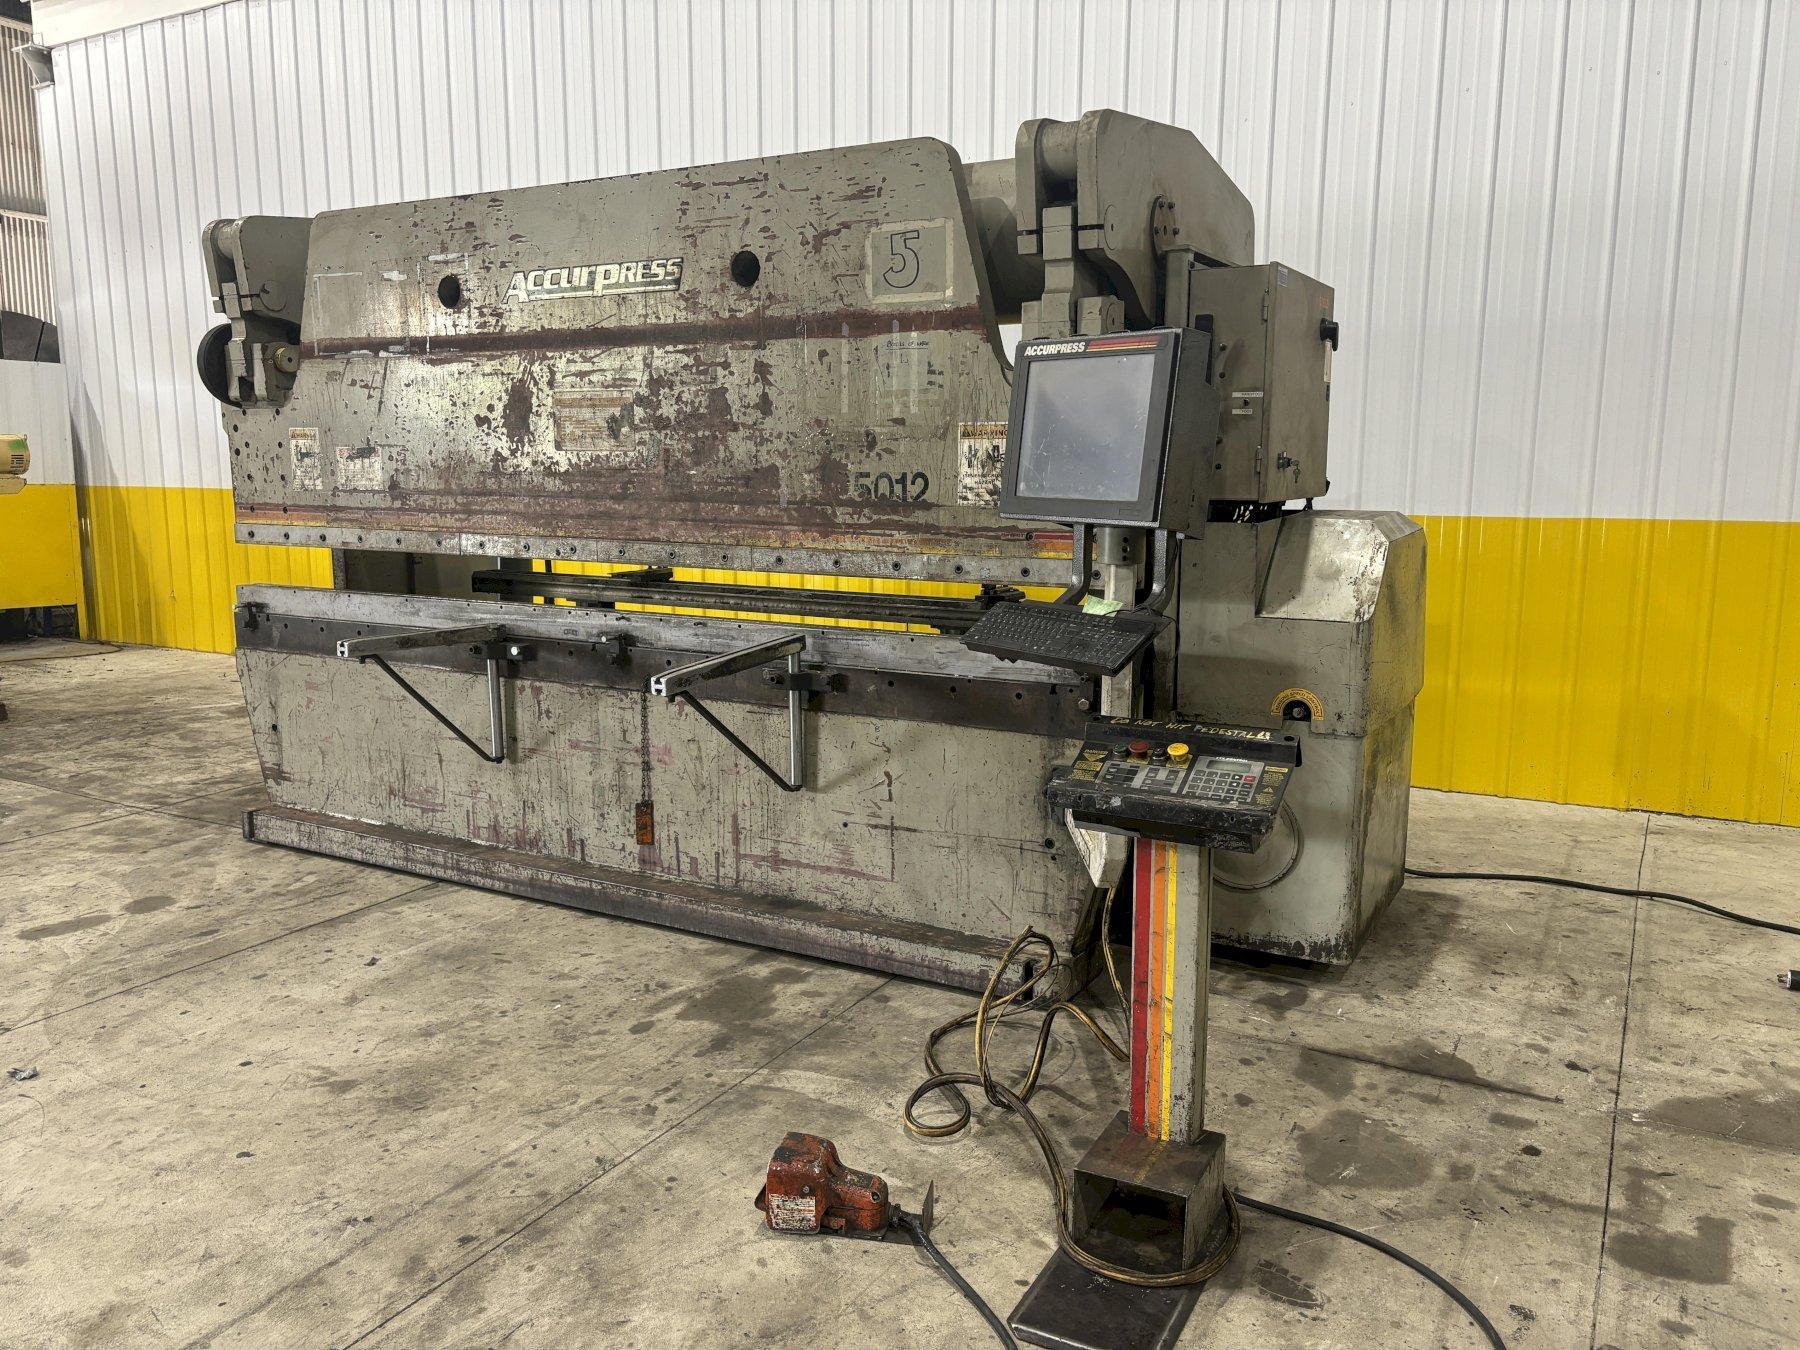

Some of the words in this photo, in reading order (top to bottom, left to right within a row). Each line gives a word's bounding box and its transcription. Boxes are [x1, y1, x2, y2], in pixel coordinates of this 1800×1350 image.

[883, 229, 920, 288] 5
[500, 257, 683, 305] ACCURPRESS
[1024, 341, 1086, 357] ACCURPRESS
[853, 471, 930, 502] 5012
[1134, 719, 1163, 727] NOT
[1165, 722, 1192, 730] HIT
